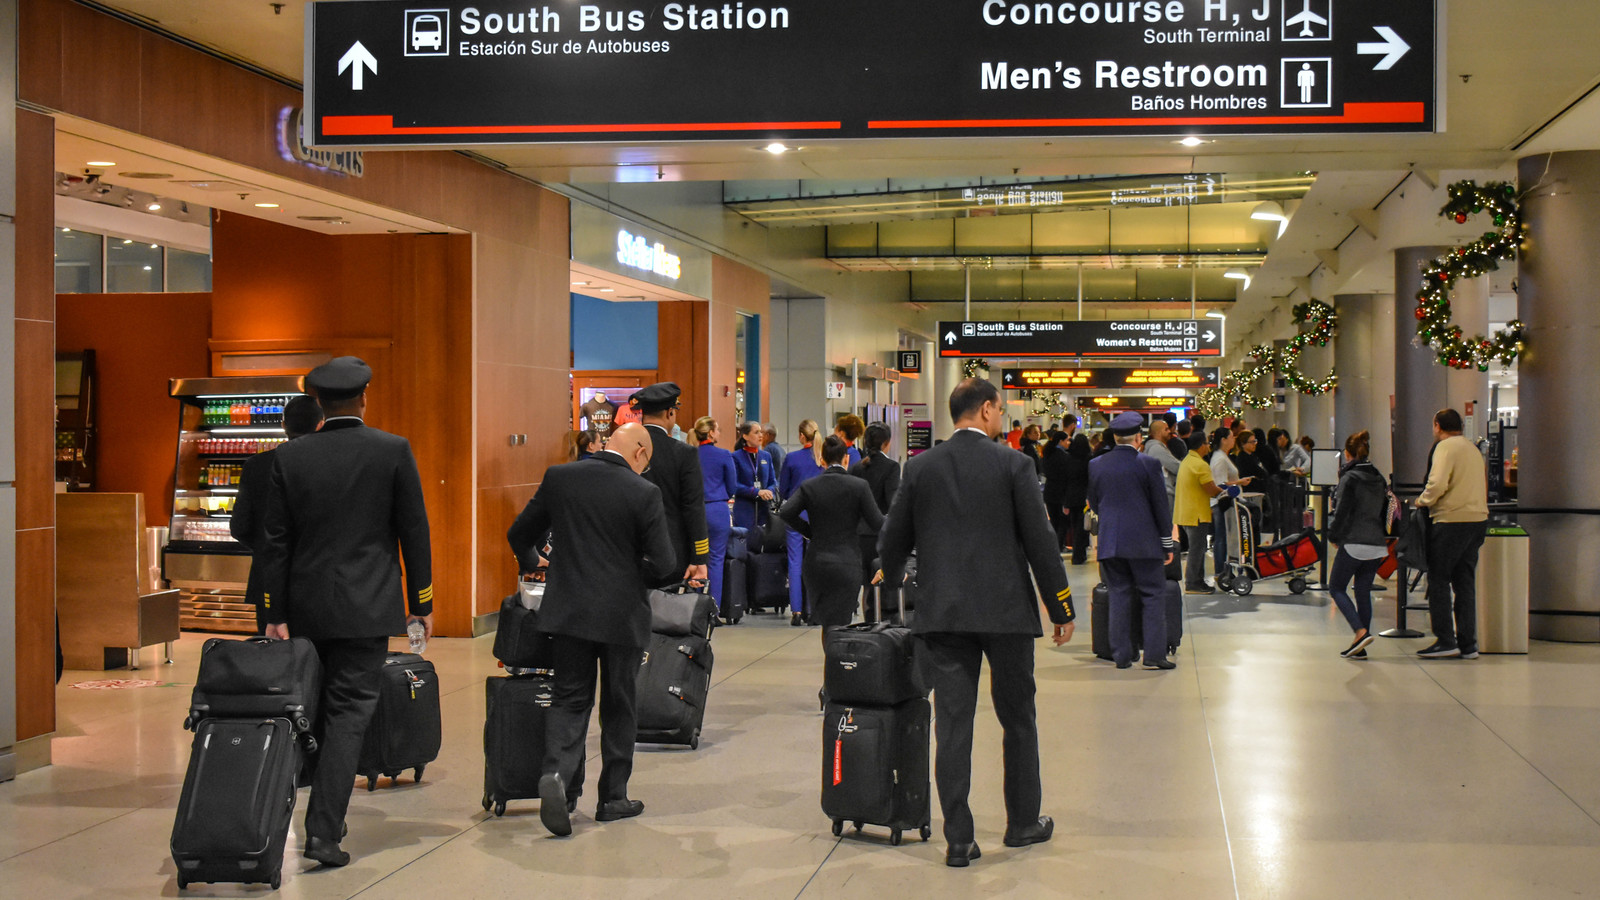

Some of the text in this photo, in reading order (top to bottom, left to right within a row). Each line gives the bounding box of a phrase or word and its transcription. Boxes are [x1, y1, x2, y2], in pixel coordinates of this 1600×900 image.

[460, 2, 789, 34] South Bus Station
[982, 0, 1270, 26] Concourse H, J
[1143, 28, 1270, 43] South Terminal
[459, 38, 670, 55] Estación Sur de Autobuses
[1095, 60, 1267, 88] Restroom
[1131, 94, 1267, 111] Baños Hombres
[977, 322, 1064, 331] South Bus Station
[1110, 322, 1162, 331] Concourse
[1176, 322, 1183, 330] J
[1138, 337, 1183, 347] Restroom
